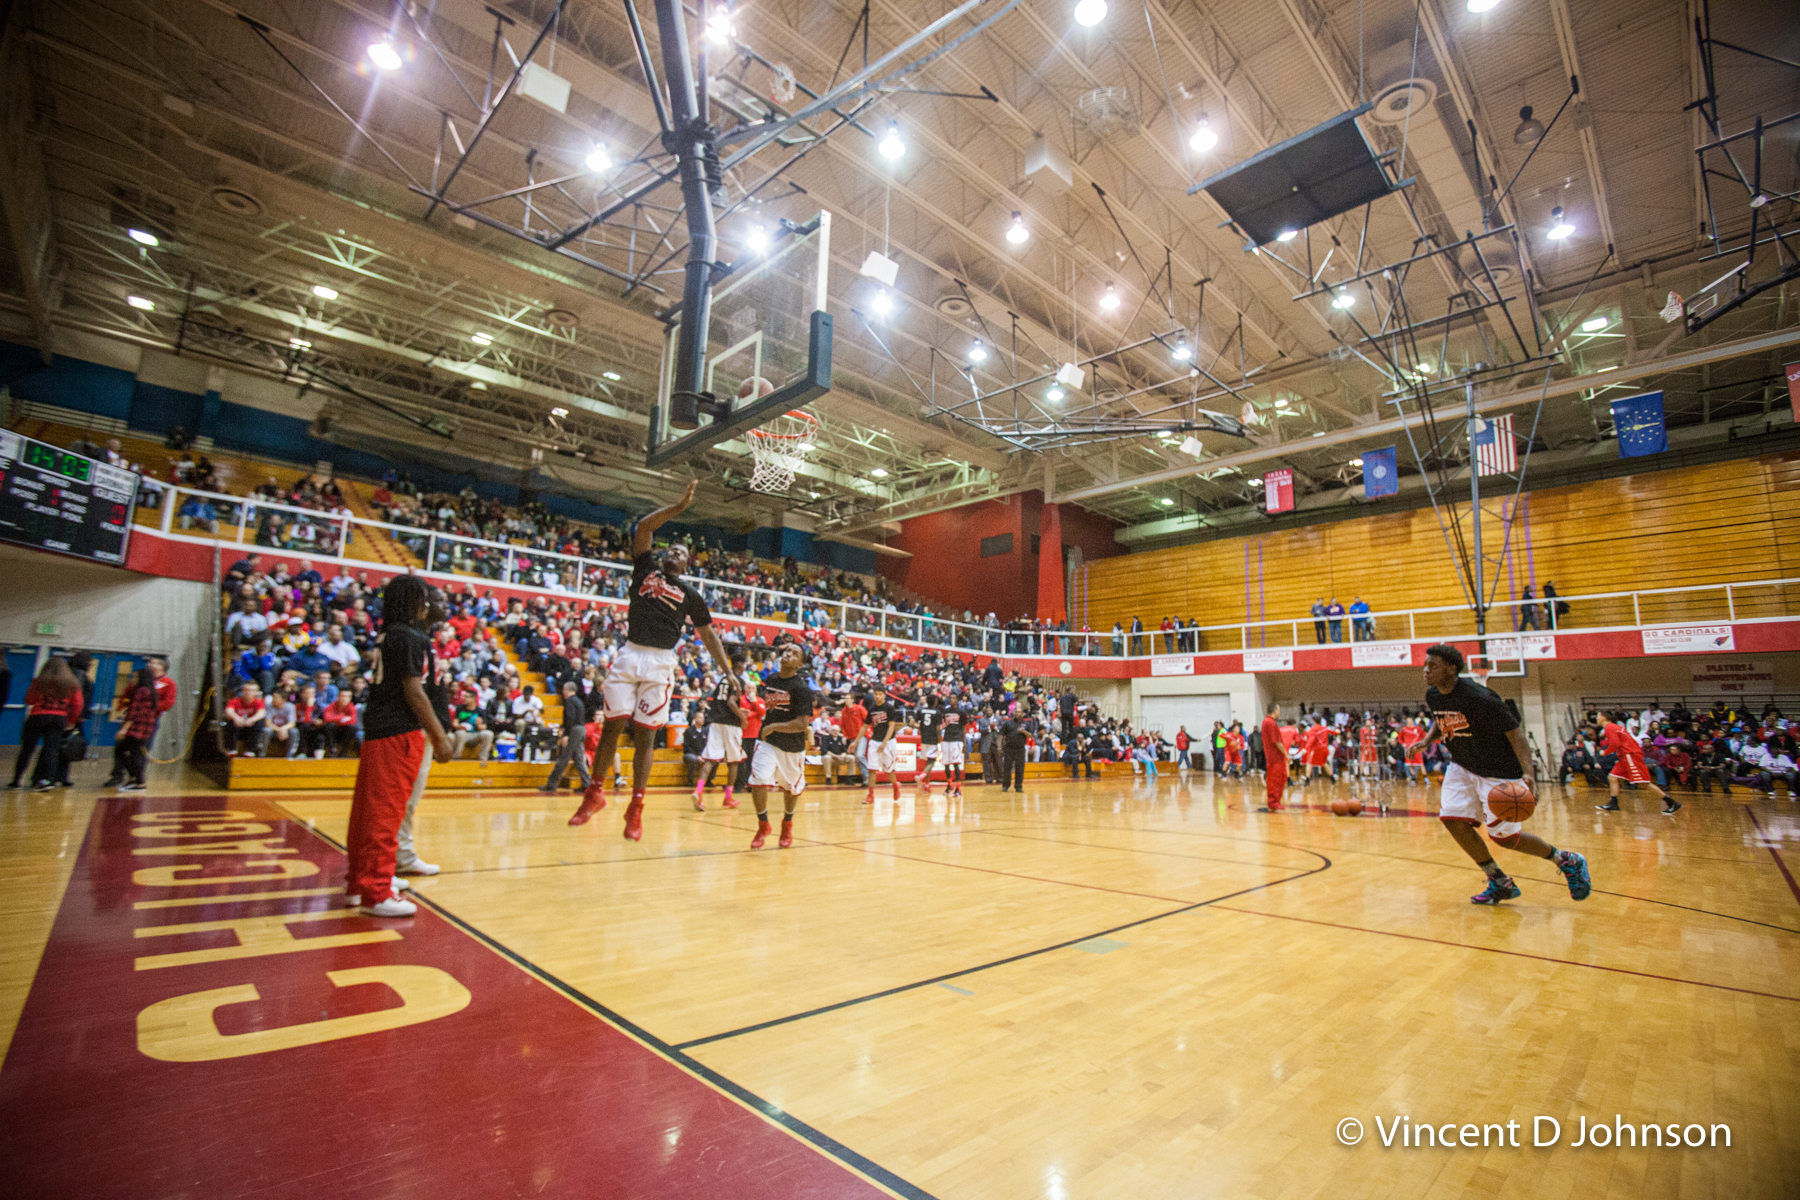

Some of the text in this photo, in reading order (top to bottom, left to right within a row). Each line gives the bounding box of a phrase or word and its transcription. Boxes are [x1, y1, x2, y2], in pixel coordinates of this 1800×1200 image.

[12, 476, 46, 492] BONUS
[38, 472, 71, 488] PERIOD
[60, 489, 89, 503] BONUS
[92, 487, 131, 505] GUEST
[24, 501, 60, 517] PLAYER
[43, 538, 71, 551] GAME
[1663, 627, 1729, 636] CARDINALS!
[638, 699, 650, 715] EC
[923, 713, 932, 726] 5
[131, 810, 472, 1063] CHICAGO
